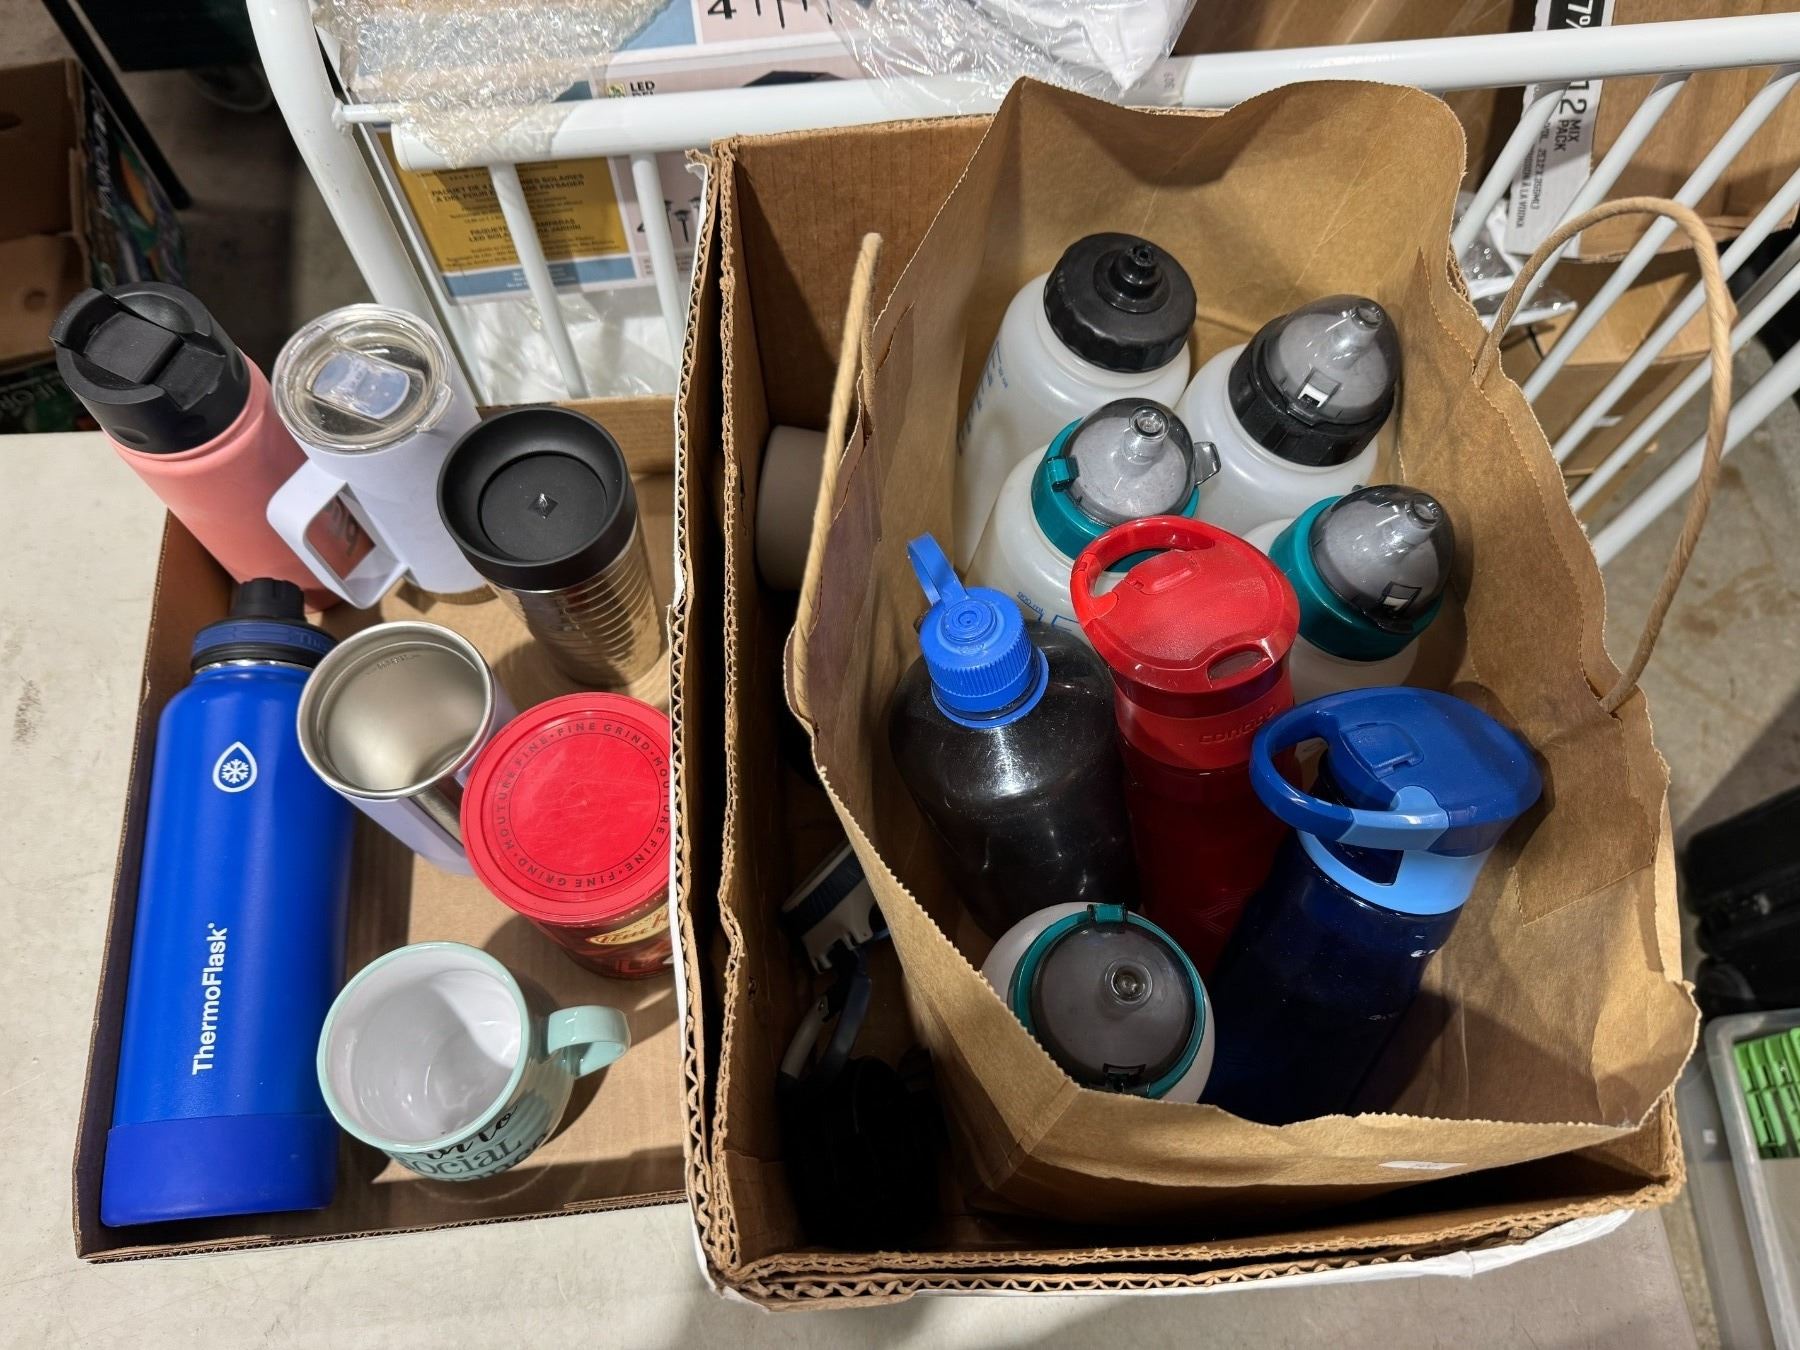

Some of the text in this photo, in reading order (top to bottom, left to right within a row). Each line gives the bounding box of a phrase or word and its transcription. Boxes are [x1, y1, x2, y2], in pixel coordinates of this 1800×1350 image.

[707, 0, 737, 20] 4
[629, 80, 656, 93] LED
[1553, 119, 1568, 152] PACK
[1567, 119, 1582, 143] MIX
[556, 721, 598, 738] FINE
[603, 723, 650, 751] GRIND
[515, 736, 549, 768] FINE
[496, 771, 516, 850] MOUTURE
[624, 838, 658, 873] FINE
[517, 858, 567, 886] GRIND
[574, 871, 617, 888] FINE
[191, 926, 228, 1076] ThermoFlask
